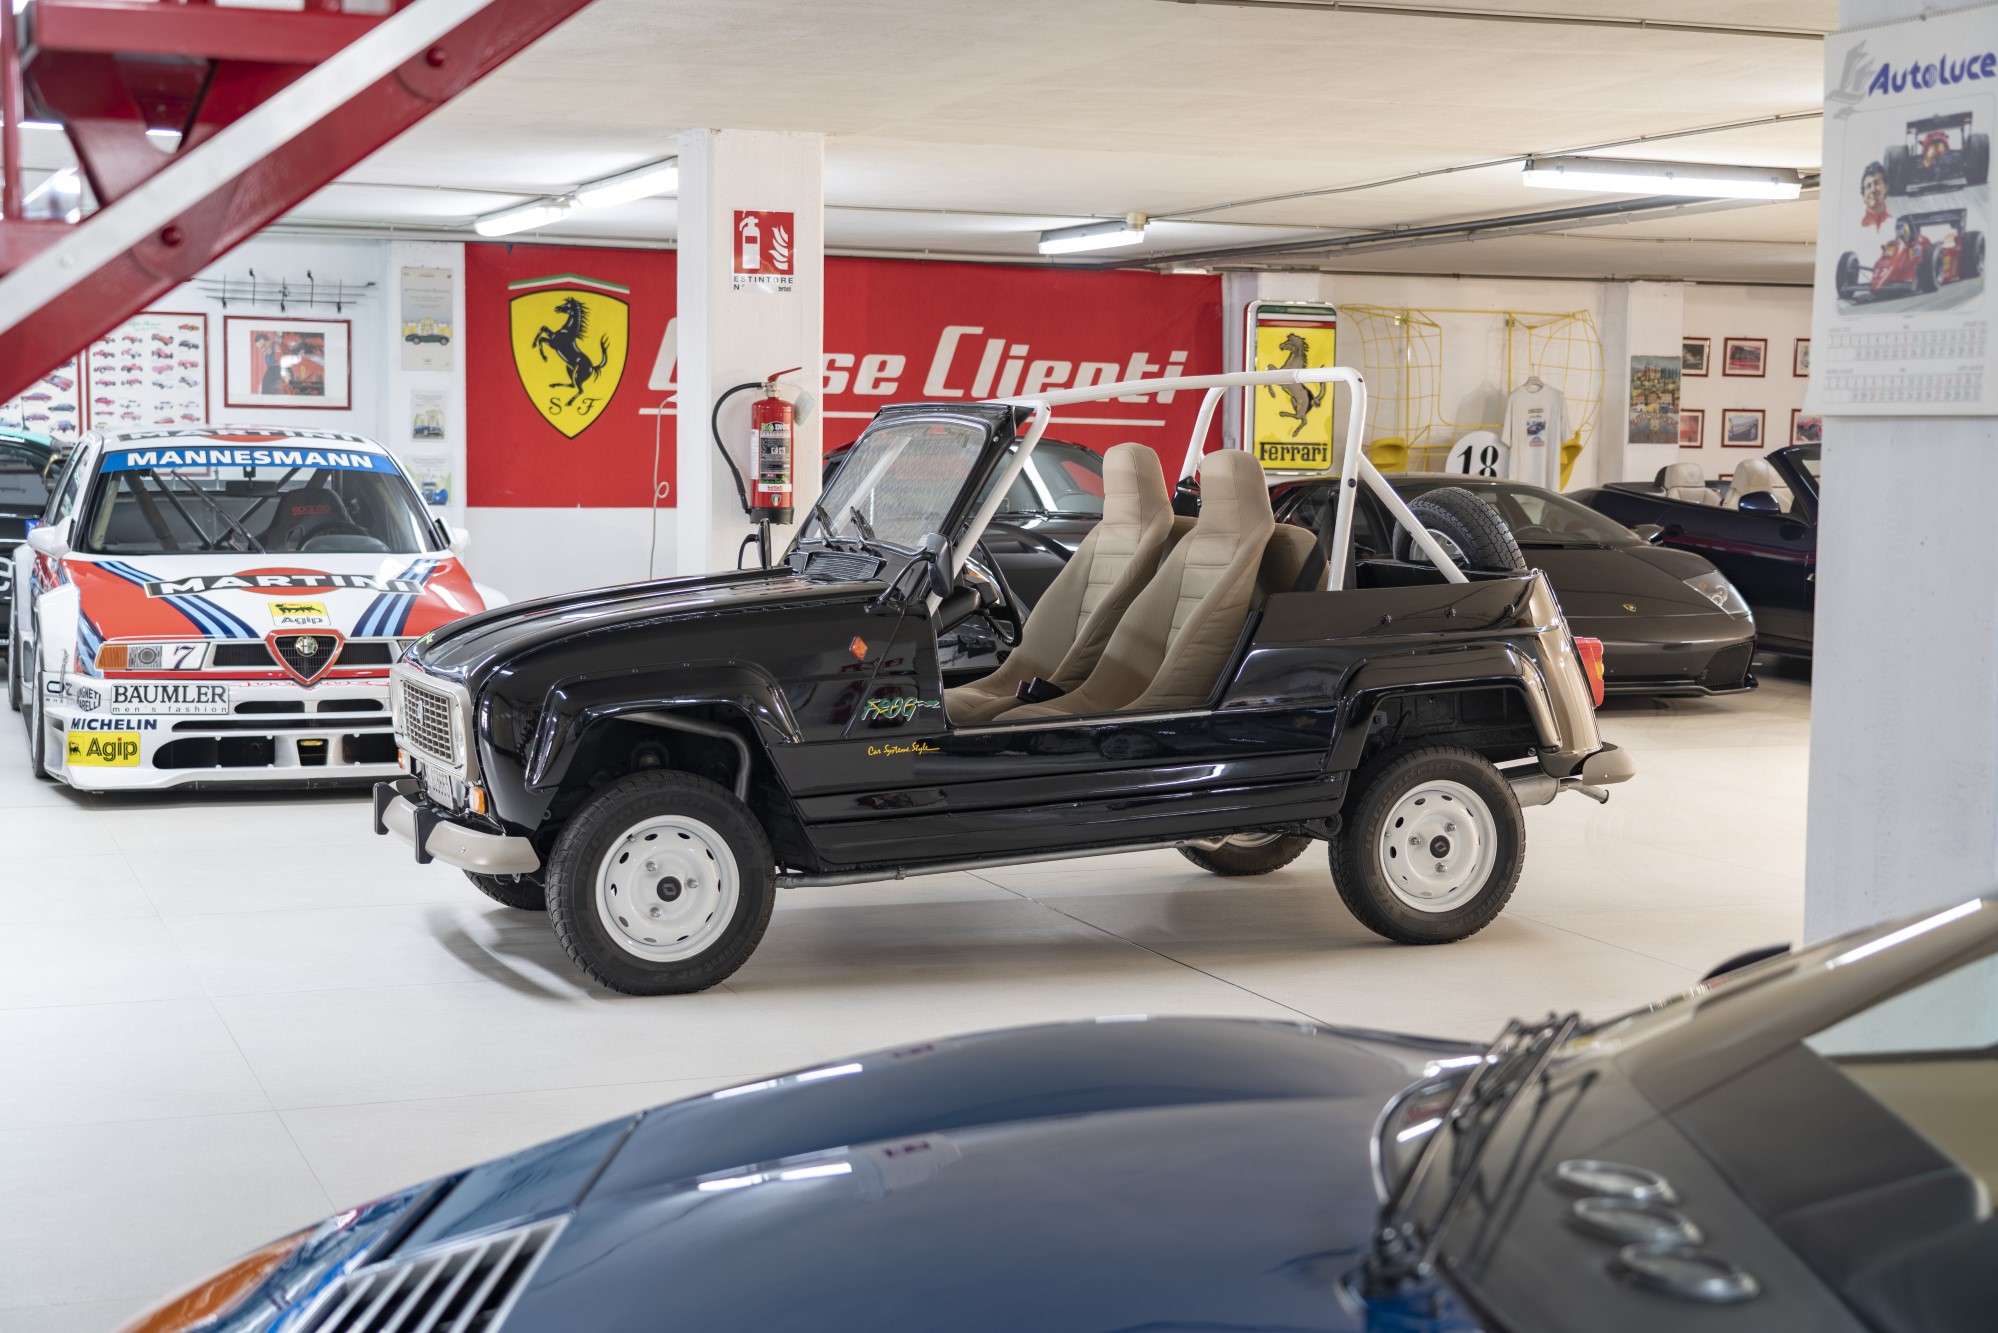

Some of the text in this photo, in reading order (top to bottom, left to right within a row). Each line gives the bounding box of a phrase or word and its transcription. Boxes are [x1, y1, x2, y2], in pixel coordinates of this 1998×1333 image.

[1868, 52, 1997, 97] Autoluce
[734, 275, 793, 284] ESTINTORE
[923, 325, 1188, 404] Clienti
[129, 429, 355, 441] MARTINI
[127, 450, 373, 468] MANNESMANN
[1259, 442, 1327, 462] Ferrari
[1457, 445, 1498, 477] 18
[160, 575, 413, 594] MARTINI
[281, 616, 323, 626] Agip
[172, 646, 195, 670] 7
[113, 705, 227, 713] men's fashion
[71, 718, 157, 730] MICHELIN
[86, 737, 138, 762] Agip
[868, 746, 881, 755] Car
[912, 742, 939, 755] Style
